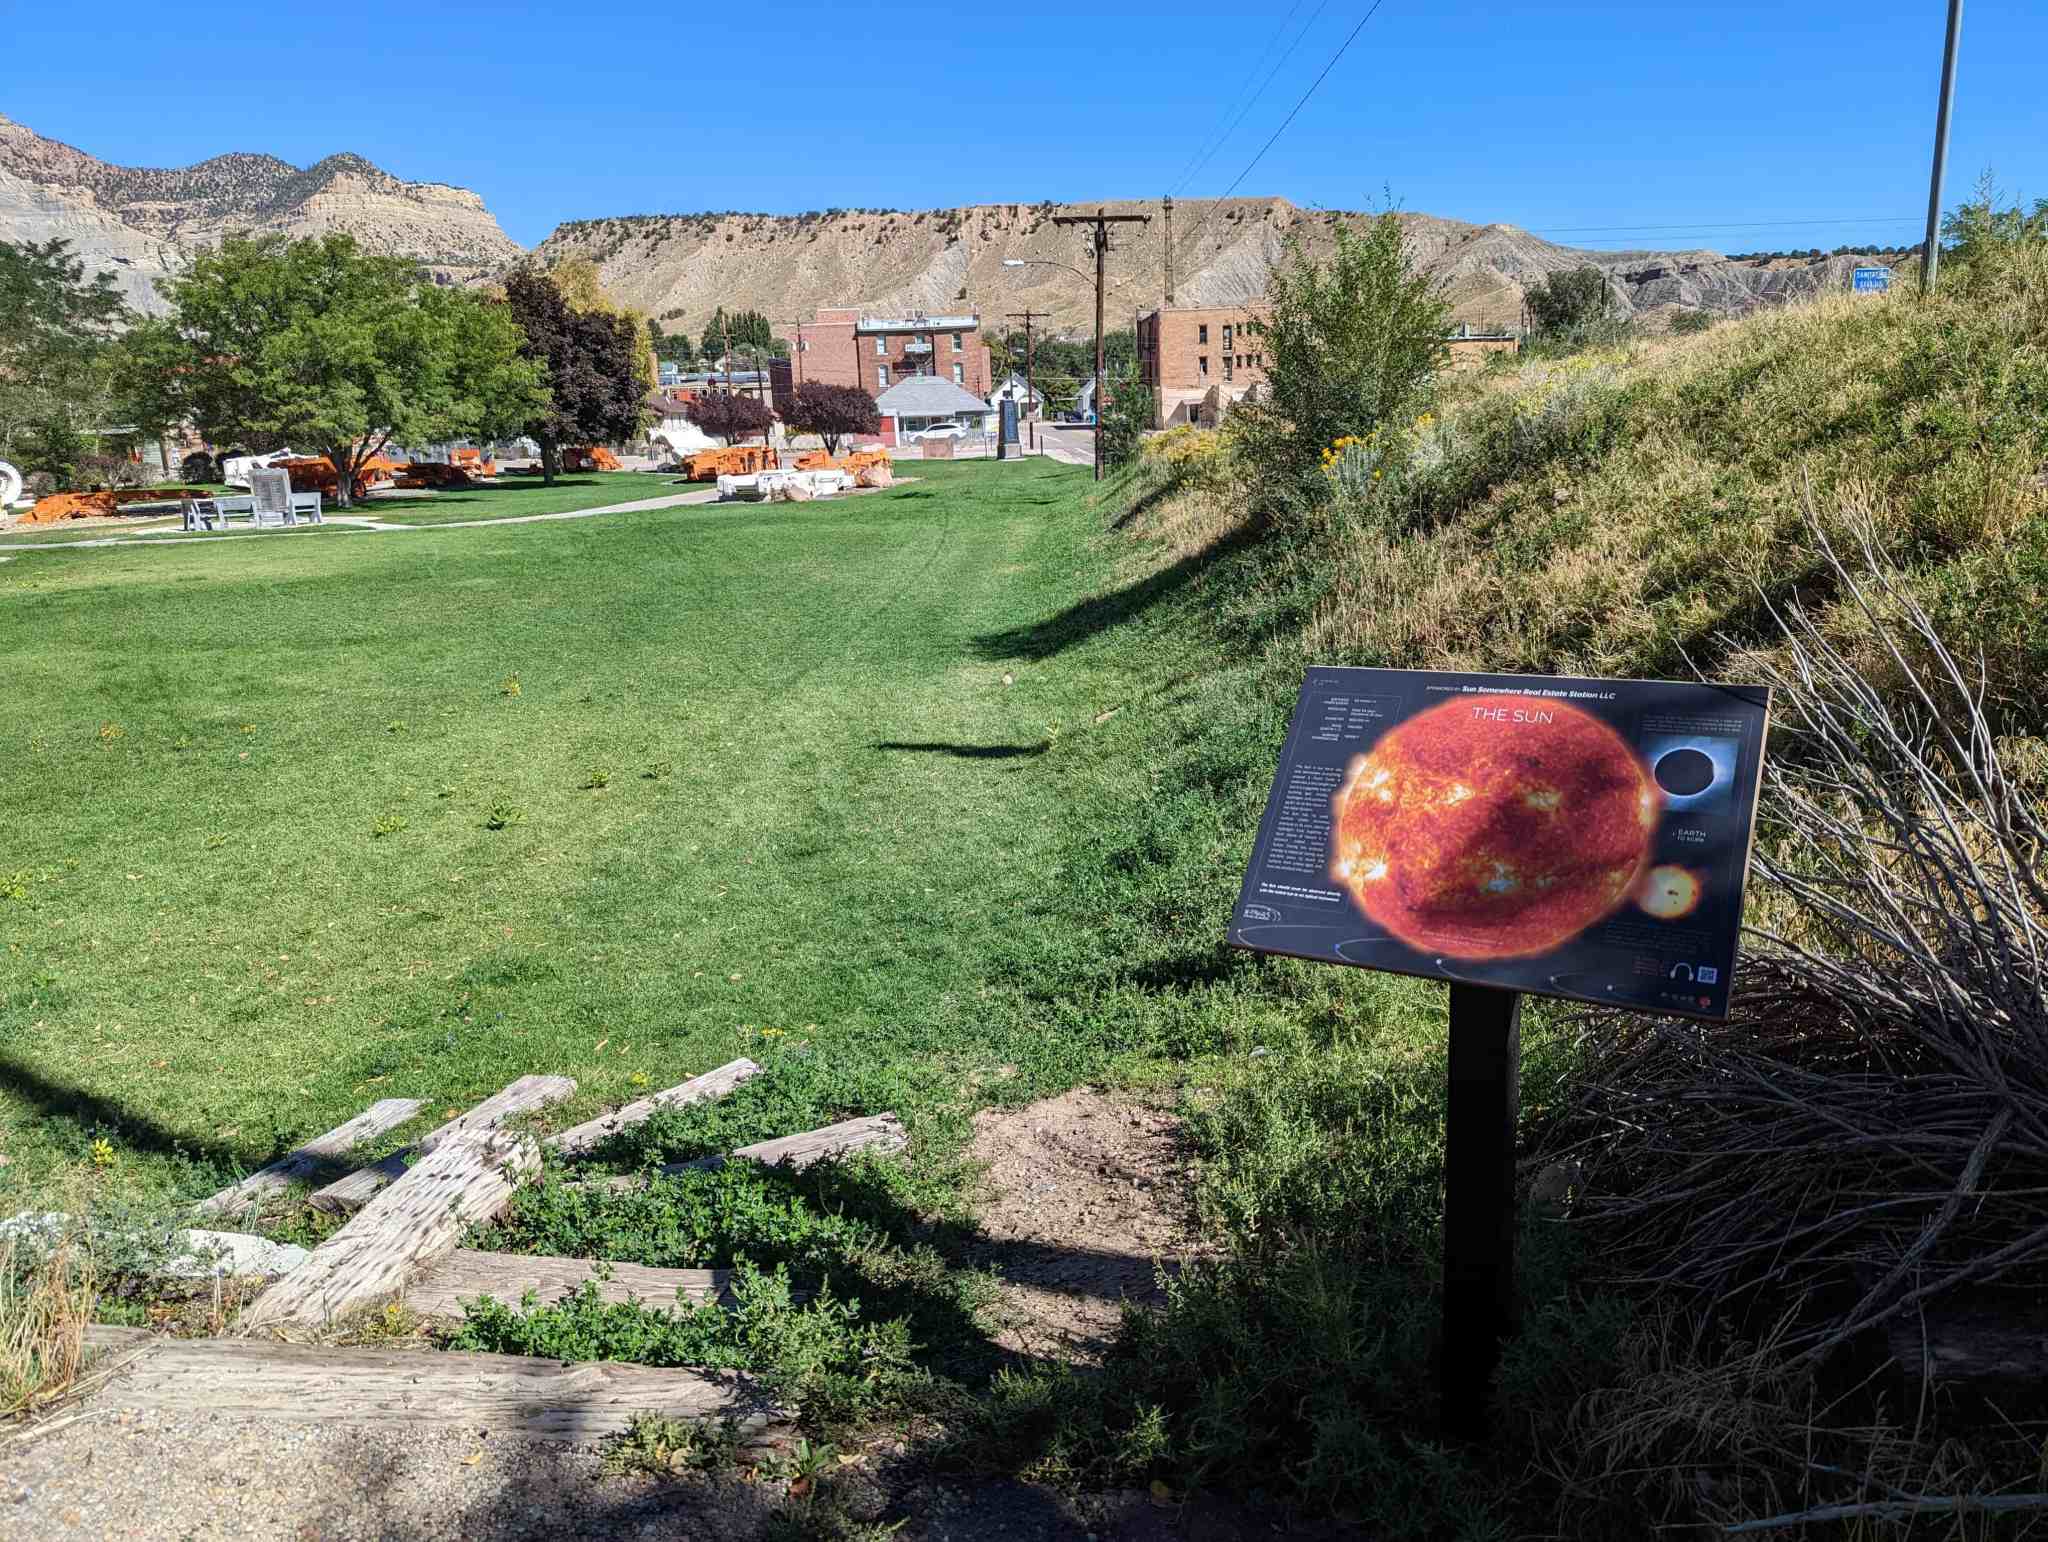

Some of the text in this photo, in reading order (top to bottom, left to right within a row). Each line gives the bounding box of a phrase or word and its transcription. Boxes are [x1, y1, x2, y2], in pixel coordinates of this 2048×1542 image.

[1462, 685, 1477, 693] Sun
[1478, 687, 1522, 695] Somewhere
[1523, 688, 1541, 696] Real
[1542, 689, 1567, 698] Estate
[1568, 691, 1598, 699] Station
[1599, 692, 1616, 700] LLC
[1472, 706, 1553, 724] THE SUN
[1678, 829, 1706, 837] EARTH
